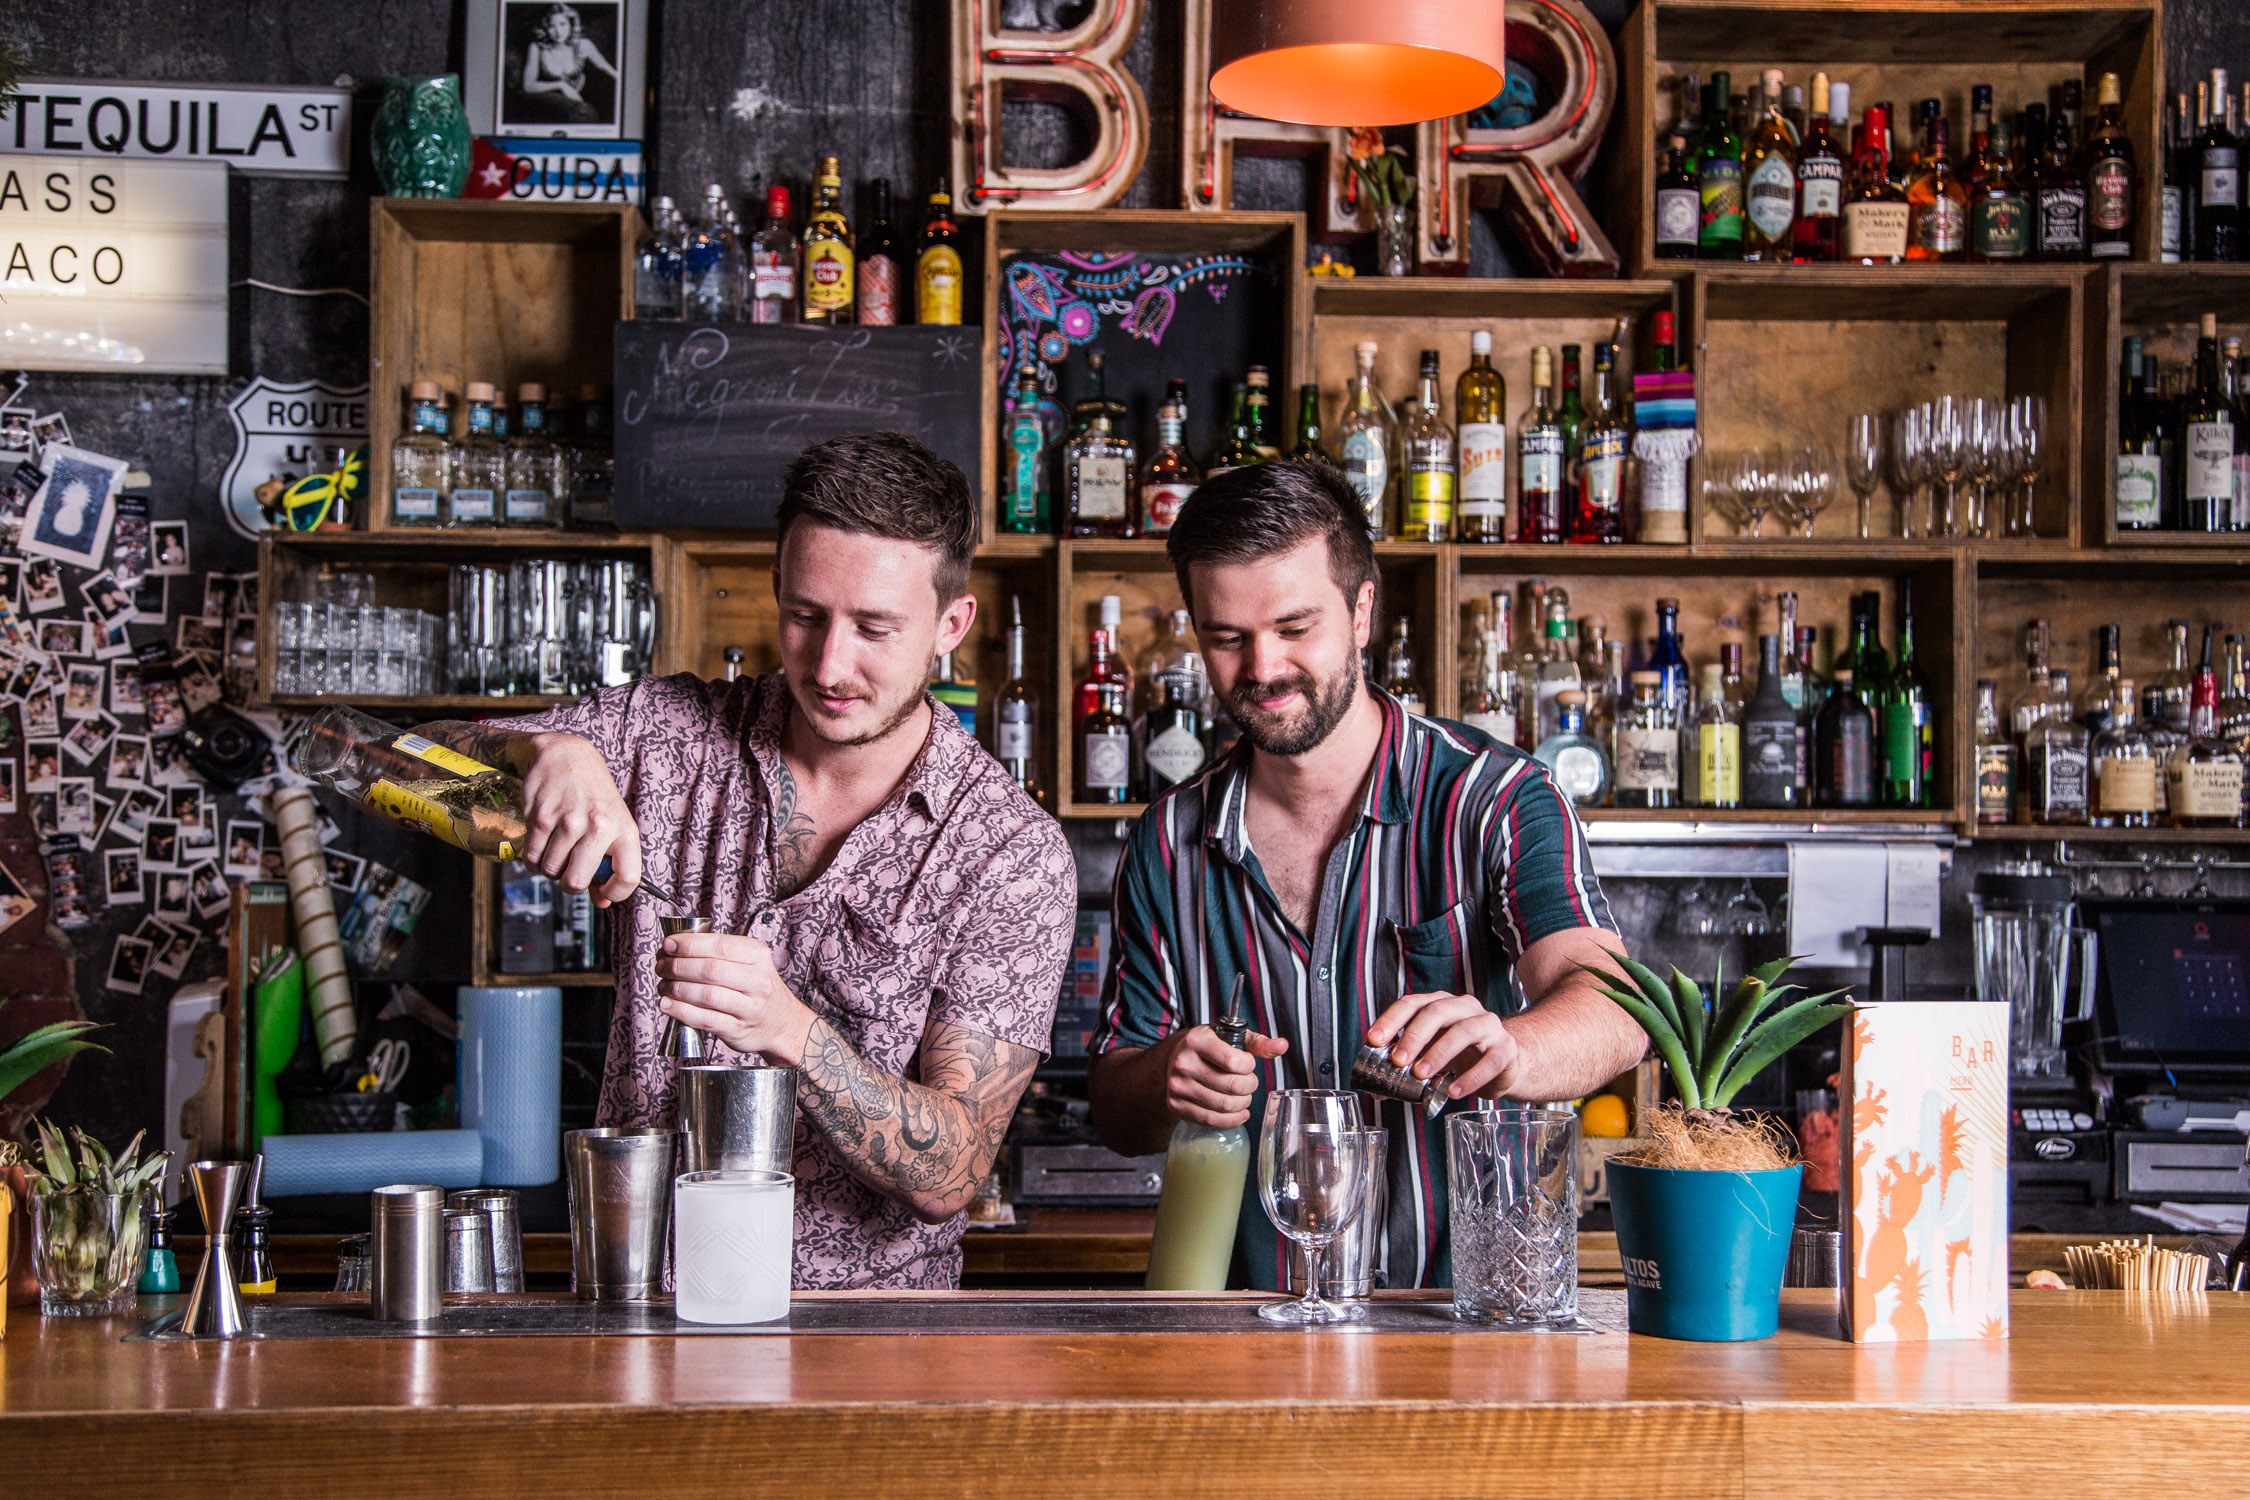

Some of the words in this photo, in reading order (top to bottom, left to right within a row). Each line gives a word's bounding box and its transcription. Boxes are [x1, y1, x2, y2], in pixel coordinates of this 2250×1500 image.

[8, 95, 296, 157] TEQUILA
[299, 103, 339, 132] ST
[510, 156, 629, 201] CUBA
[1797, 163, 1844, 179] CAMPAR
[0, 170, 116, 214] ASS
[5, 241, 123, 285] ACO
[267, 400, 366, 429] ROUTE
[1520, 438, 1564, 454] AMPARI
[1583, 439, 1625, 460] APEOL
[1951, 1035, 1993, 1069] BAR
[1950, 1075, 1973, 1086] MENU
[1621, 1255, 1661, 1280] ALTOS
[1638, 1278, 1662, 1290] AGAVE
